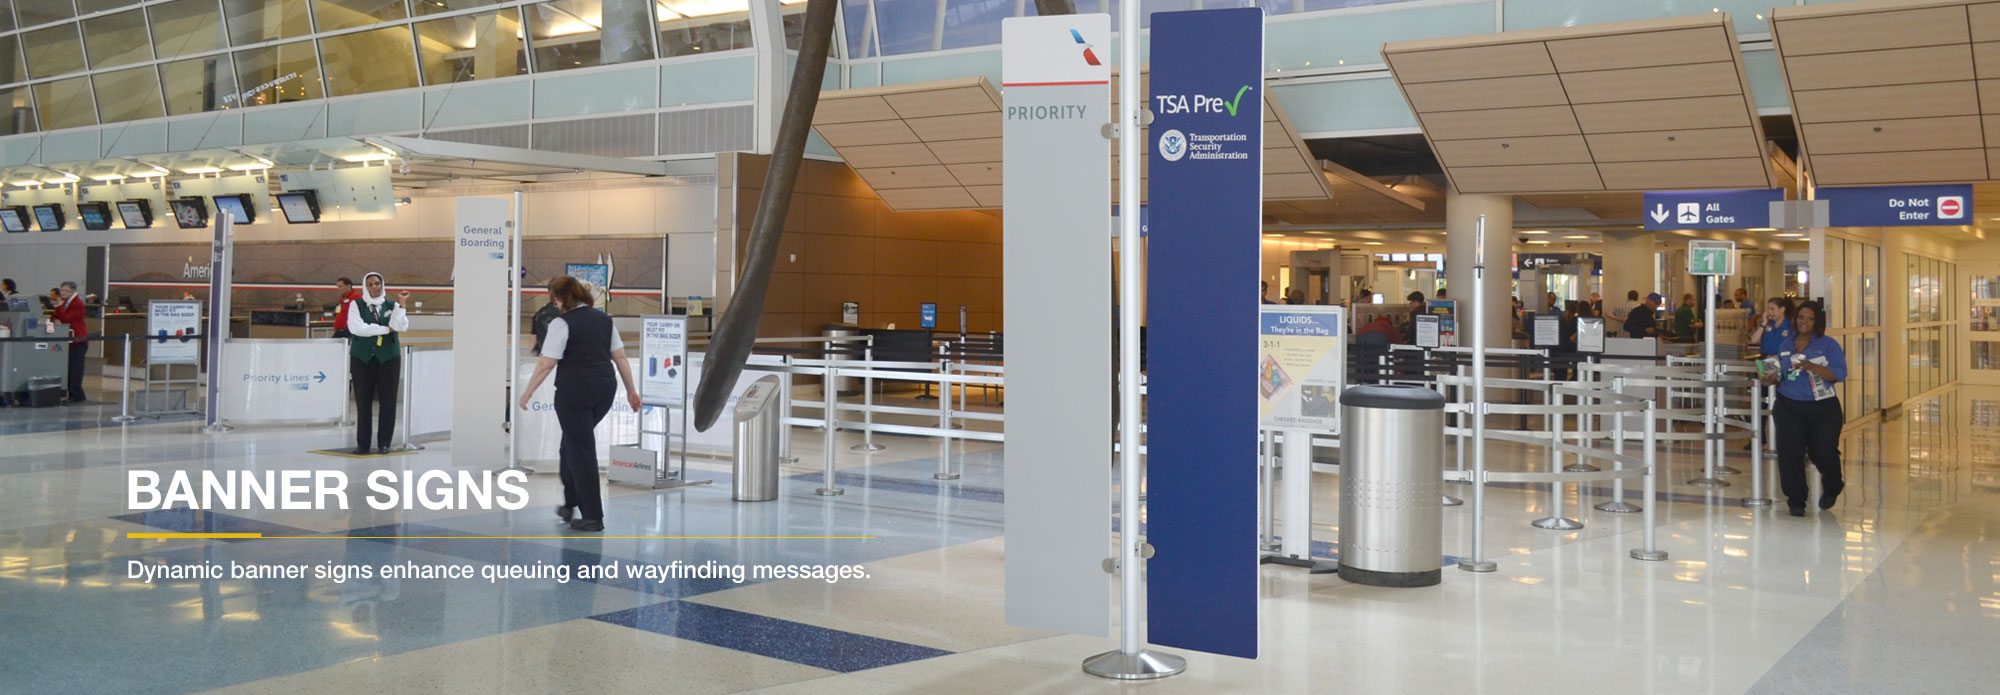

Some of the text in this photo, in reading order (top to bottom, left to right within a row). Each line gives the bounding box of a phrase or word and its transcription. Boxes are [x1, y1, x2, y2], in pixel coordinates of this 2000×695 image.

[1156, 94, 1224, 114] TSA Pre
[1008, 105, 1087, 120] PRIORITY
[1189, 133, 1247, 143] Transportation
[1189, 143, 1222, 152] Security
[1189, 152, 1248, 160] Administration
[1706, 203, 1720, 212] All
[1889, 198, 1930, 208] Do Not
[1706, 214, 1735, 225] Gates
[1899, 210, 1930, 220] Enter
[463, 225, 502, 235] General
[460, 238, 504, 250] Boarding
[1703, 253, 1714, 271] 1
[1270, 326, 1295, 335] They're
[1263, 340, 1280, 348] 3-1-1
[284, 374, 310, 382] Lines
